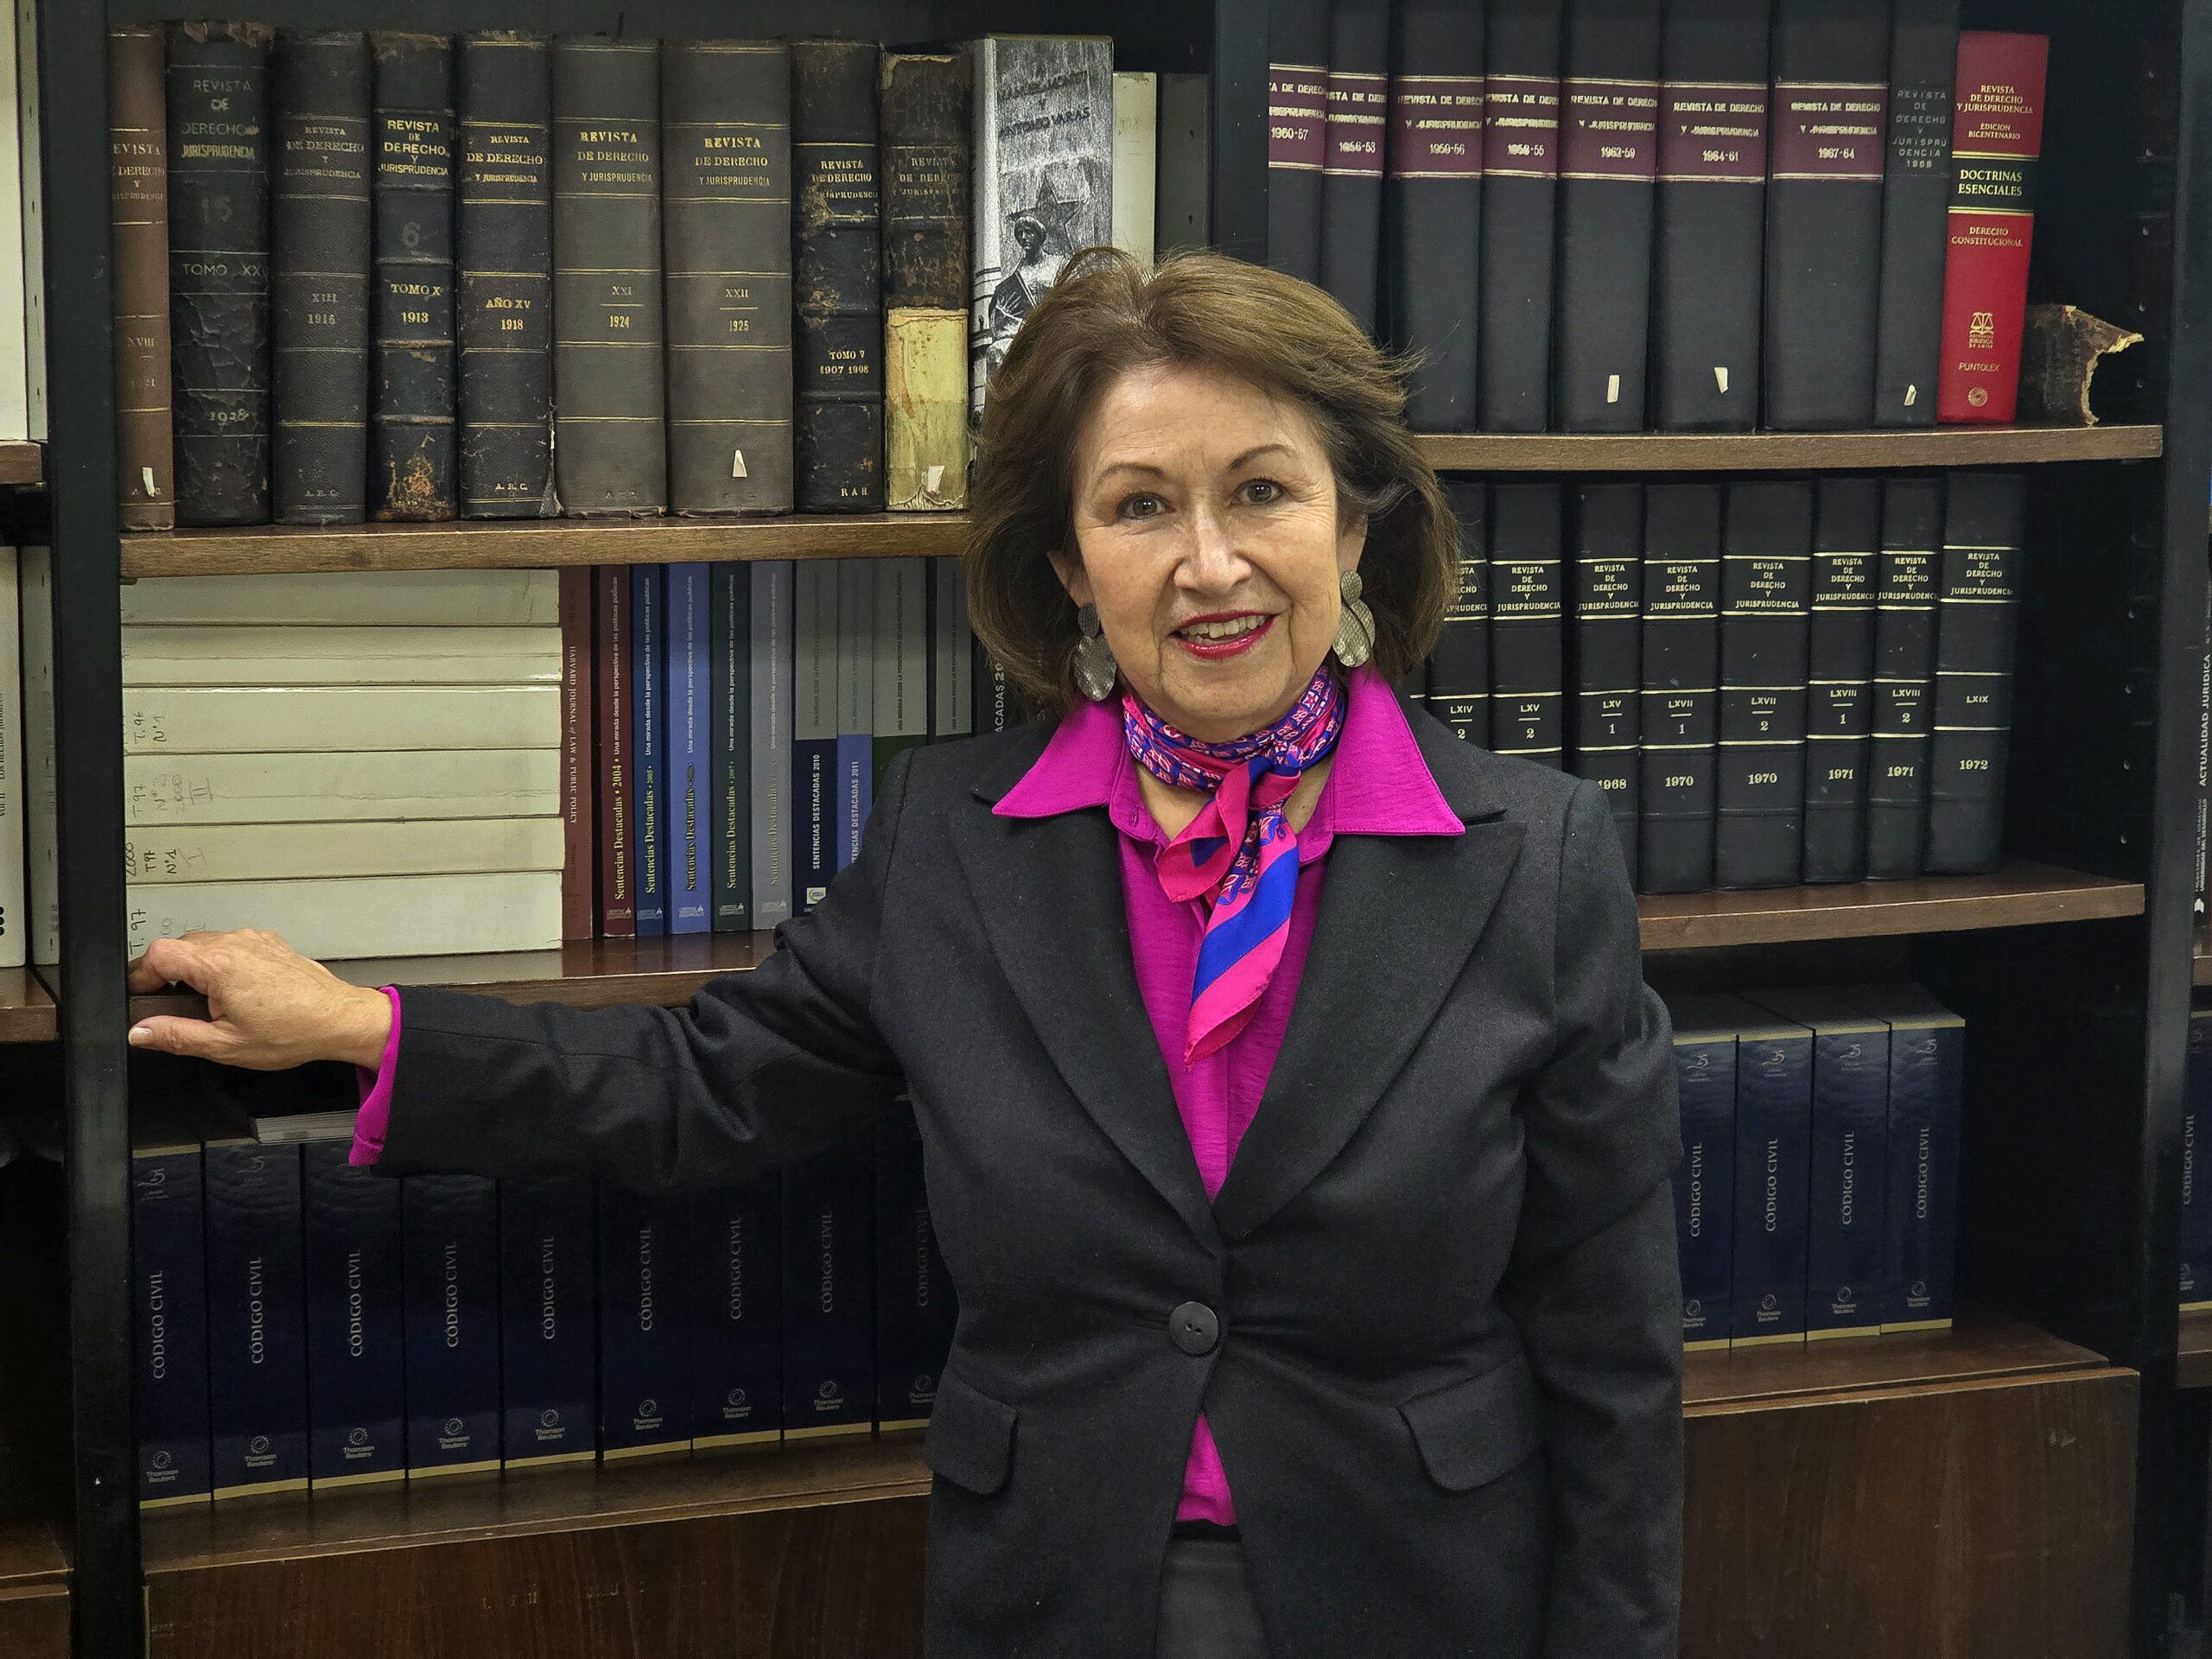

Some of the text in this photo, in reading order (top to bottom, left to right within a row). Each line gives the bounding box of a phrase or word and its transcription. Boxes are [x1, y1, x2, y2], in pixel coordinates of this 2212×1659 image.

[194, 80, 252, 92] REVISTA
[1980, 86, 2014, 94] REVISTA
[1440, 96, 1452, 105] DE
[1571, 95, 1609, 105] REVISTA
[1897, 90, 1946, 100] REVISTA
[1984, 94, 2023, 105] DERECHO
[1674, 103, 1764, 113] REVISTA DE DERECHO
[1830, 103, 1842, 111] DE
[1846, 103, 1881, 112] DERECHO
[1914, 102, 1927, 111] DE
[1963, 103, 2033, 114] JURISPRUDENCIA
[1896, 115, 1945, 124] DERECHO
[304, 127, 346, 136] REVISTA
[388, 120, 440, 133] REVISTA
[490, 136, 529, 144] REVISTA
[581, 131, 638, 143] REVISTA
[1968, 130, 2020, 140] BICENTENARIO
[704, 137, 761, 149] REVISTA
[385, 142, 446, 156] DERECHO
[467, 153, 543, 165] DE DERECHO
[577, 151, 649, 162] DE DERECHO
[695, 156, 768, 167] DE DERECHO
[378, 162, 448, 175] JURISPRUDENCIA
[821, 159, 864, 170] REVISTA
[118, 167, 165, 176] DERECHO
[1960, 169, 2023, 182] DOCTRINAS
[589, 172, 652, 183] JURISPRUDENCIA
[705, 175, 771, 187] JURISPRUDENCIA
[827, 173, 872, 183] DERECHO
[1958, 183, 2023, 197] ESENCIALES
[1969, 226, 2009, 237] DERECHO
[1951, 236, 2023, 247] CONSTITUCIONAL
[182, 264, 227, 276] TOMO
[391, 283, 442, 296] TOMO X
[725, 289, 748, 298] XXII
[486, 297, 531, 309] AÑO XV
[401, 311, 429, 323] 1913
[609, 315, 630, 327] 1924
[501, 319, 524, 331] 1918
[728, 320, 749, 332] 1925
[830, 350, 865, 360] TOMO V
[820, 365, 844, 374] 1907
[1959, 362, 1999, 372] PUNTOLEX
[209, 410, 250, 423] 1928
[1967, 552, 1999, 561] REVISTA
[1593, 583, 1628, 592] DERECHO
[1497, 602, 1560, 612] JURISPRUDENCIA
[1649, 602, 1713, 611] JURISPRUDENCIA
[1735, 600, 1799, 608] JURISPRUDENCIA
[2202, 653, 2210, 709] JURIDICA
[1830, 689, 1857, 697] LXVIII
[1892, 689, 1921, 697] LXVIII
[1603, 700, 1621, 709] LXV
[1668, 700, 1694, 709] LXVII
[1751, 696, 1777, 705] LXVII
[1966, 695, 1989, 703] LXIX
[569, 688, 577, 724] JOURNAL
[1451, 705, 1472, 714] LXIV
[1521, 704, 1540, 713] LXV
[1840, 714, 1847, 725] 1
[1903, 713, 1910, 723] 2
[1610, 724, 1615, 734] 1
[1679, 724, 1685, 734] 1
[1760, 721, 1769, 731] 2
[1458, 729, 1465, 739] 2
[1527, 728, 1535, 739] 2
[2199, 713, 2209, 787] ACTUALIDAD
[1959, 760, 1988, 771] 1972
[613, 765, 622, 787] 2004
[1827, 769, 1853, 779] 1971
[1887, 766, 1915, 777] 1971
[1598, 779, 1627, 790] 1968
[1665, 776, 1694, 787] 1970
[1748, 773, 1777, 785] 1970
[613, 797, 624, 849] Destacadas
[645, 791, 656, 893] Sentencias Destacadas
[726, 786, 736, 889] Sentencias Destacadas
[615, 851, 625, 900] Sentencias
[1843, 1131, 1854, 1166] CIVIL
[1919, 1127, 1929, 1160] CIVIL
[1692, 1142, 1701, 1178] CIVIL
[1766, 1138, 1777, 1173] CIVIL
[445, 1242, 456, 1281] CIVIL
[348, 1250, 362, 1357] CÓDIGO CIVIL
[249, 1257, 264, 1364] CÓDIGO CIVIL
[150, 1271, 165, 1379] CÓDIGO CIVIL
